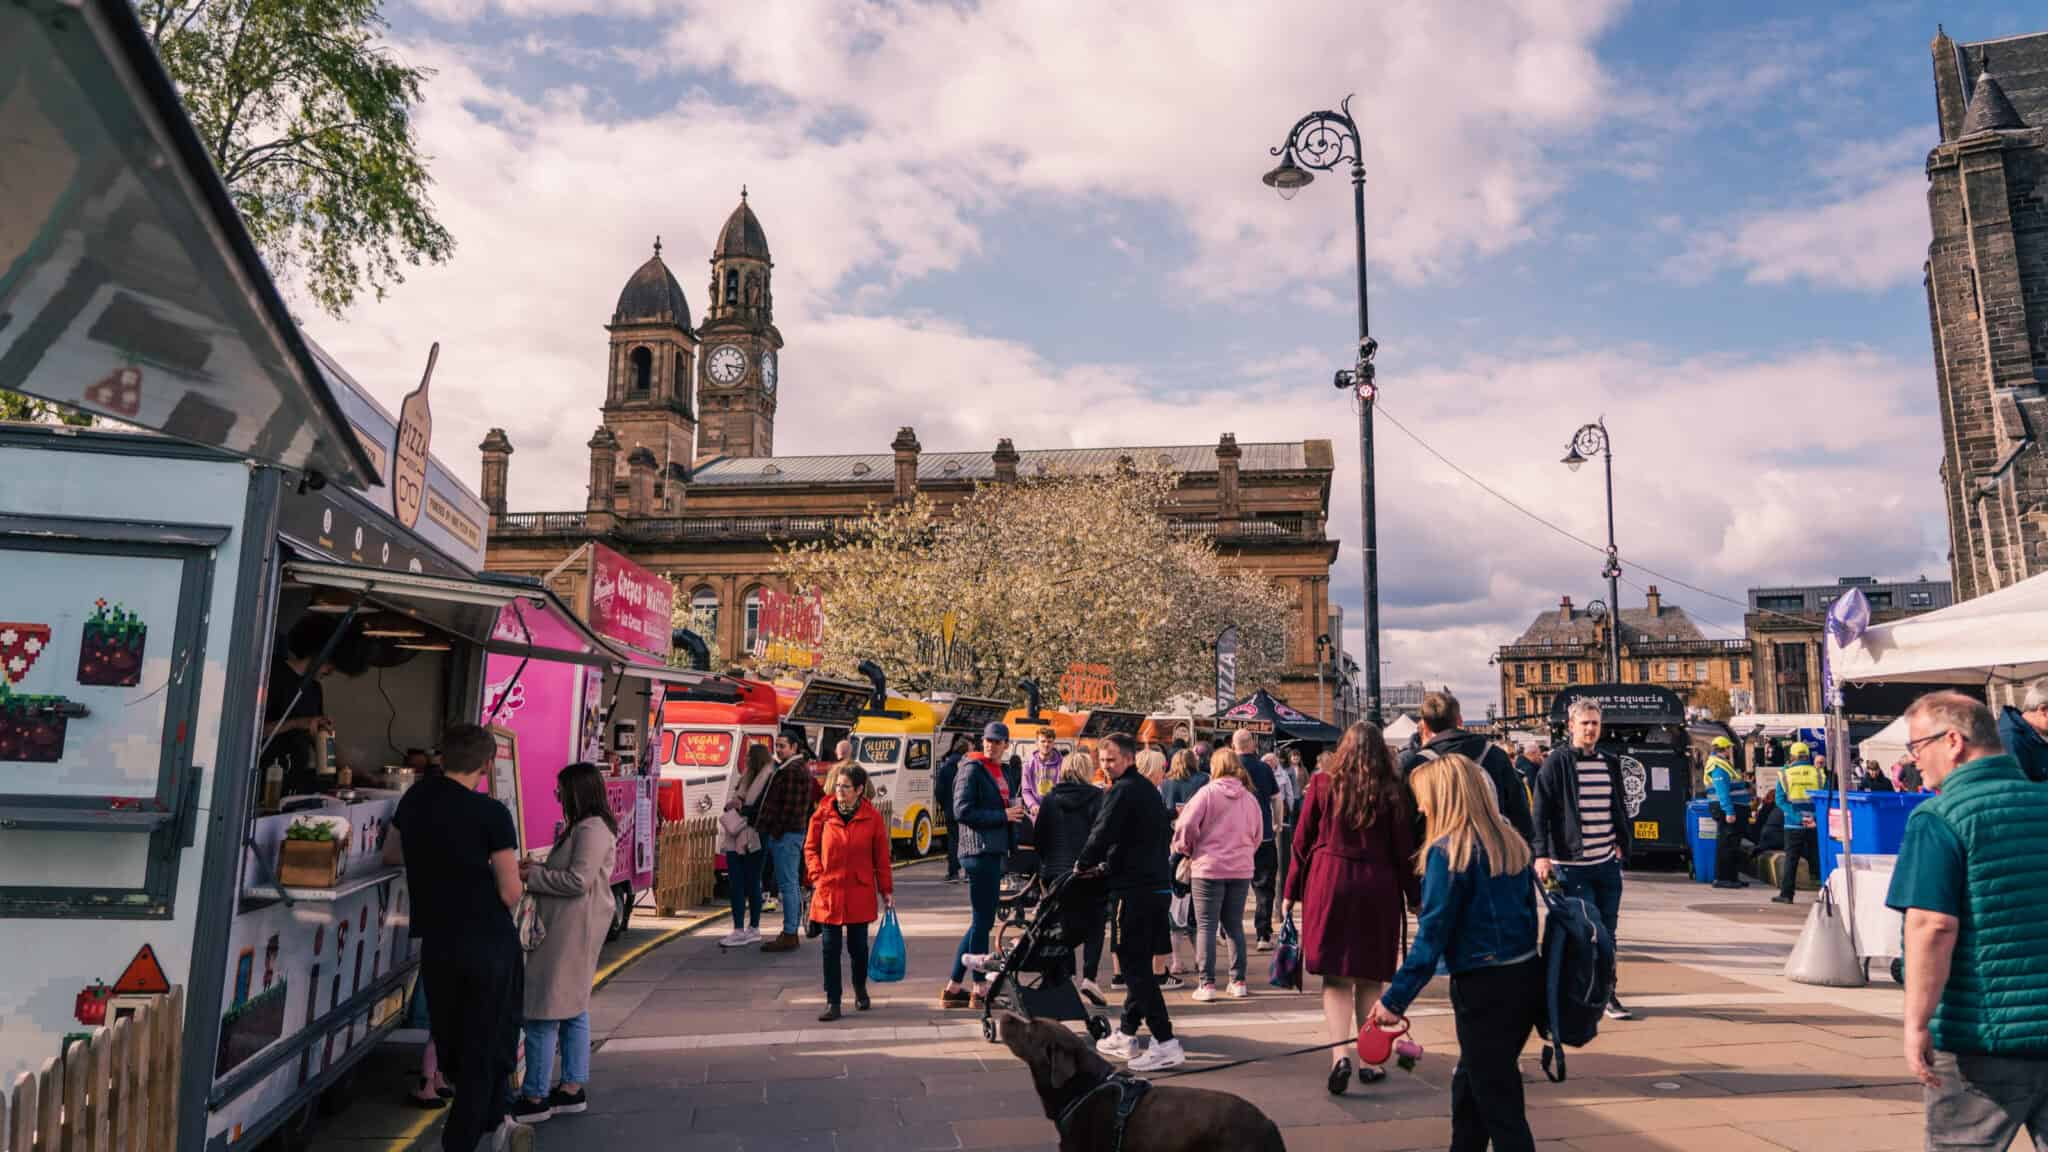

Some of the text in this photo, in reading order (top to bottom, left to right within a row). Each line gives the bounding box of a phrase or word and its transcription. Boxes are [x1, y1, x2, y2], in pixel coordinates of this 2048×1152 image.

[401, 419, 427, 457] PIZZA
[1218, 653, 1235, 710] PIZZA
[1614, 693, 1663, 705] taqueria
[687, 735, 720, 745] VEGAN
[865, 740, 897, 752] GLUTEN
[871, 750, 889, 761] FREE
